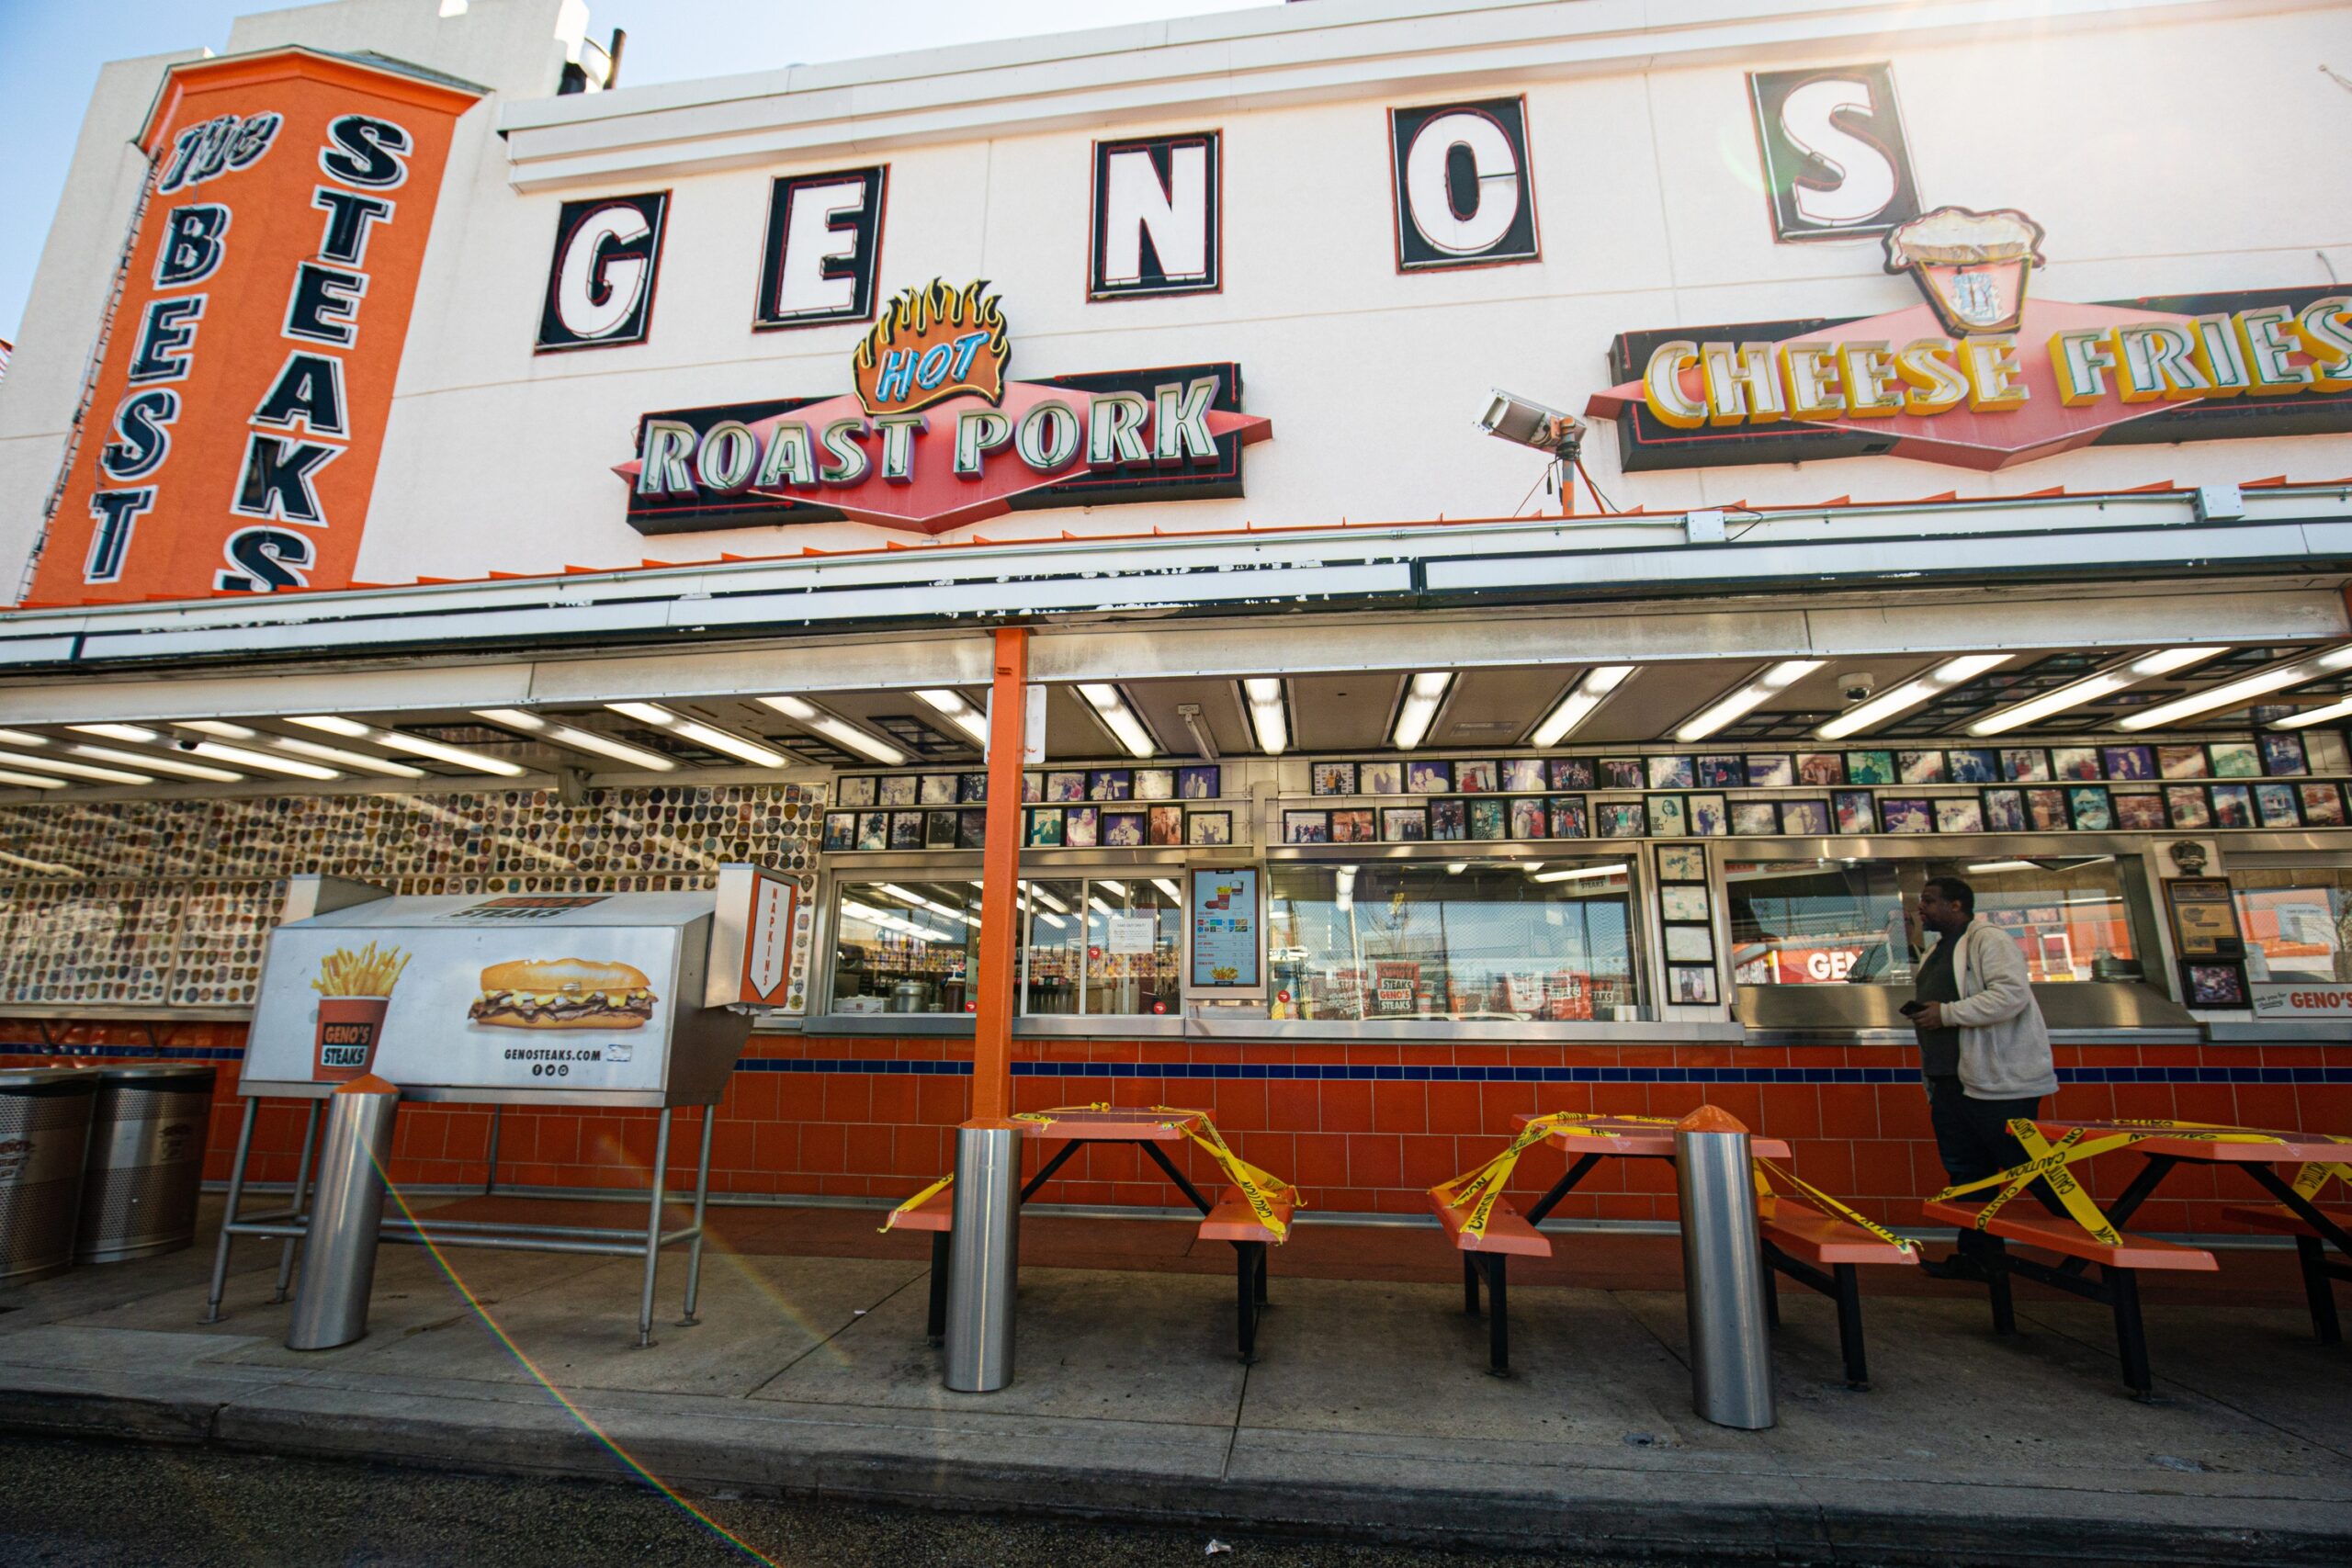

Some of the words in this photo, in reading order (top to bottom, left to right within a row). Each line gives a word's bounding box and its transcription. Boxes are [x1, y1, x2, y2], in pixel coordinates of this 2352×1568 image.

[214, 115, 413, 591] STEAKS
[876, 330, 991, 402] HOT
[1643, 334, 2029, 429] CHEESE
[2048, 296, 2352, 407] FRIES
[84, 203, 232, 584] BEST
[636, 412, 930, 503] ROAST
[954, 376, 1220, 480] PORK
[763, 887, 778, 987] NAPKINS
[1379, 990, 1411, 999] GENO'S
[1383, 979, 1412, 989] STEAKS
[1381, 1000, 1411, 1010] STEAKS
[324, 1026, 370, 1043] GENO'S
[323, 1047, 366, 1065] STEAKS
[504, 1049, 601, 1061] GENOSTEAKS.COM
[2005, 1151, 2066, 1180] CAUTION
